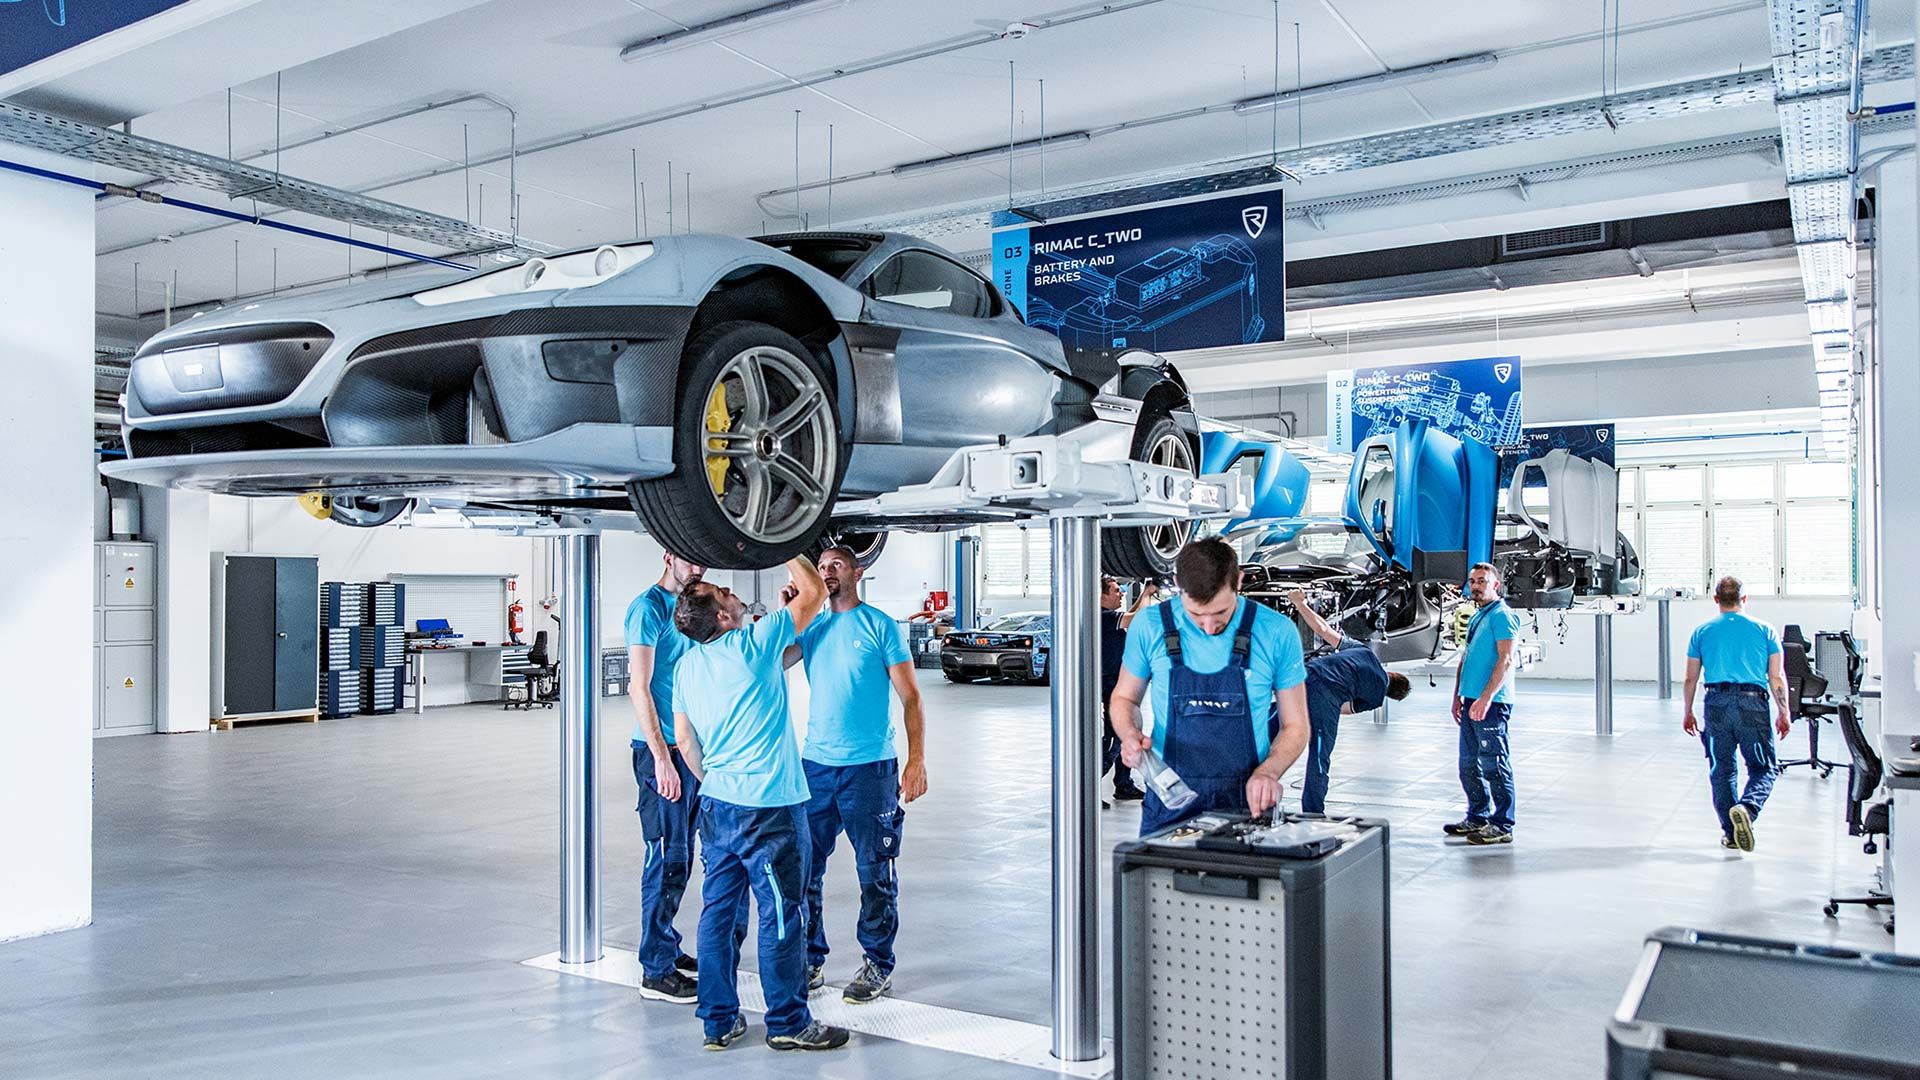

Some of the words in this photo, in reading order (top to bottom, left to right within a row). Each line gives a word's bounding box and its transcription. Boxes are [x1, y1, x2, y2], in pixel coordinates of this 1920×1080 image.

[1034, 237, 1083, 255] RIMAC
[1088, 228, 1142, 249] C_TWO
[1004, 246, 1022, 259] 03
[1034, 259, 1087, 275] BATTERY
[1089, 255, 1115, 267] AND
[1004, 269, 1012, 296] ZONE
[1034, 272, 1081, 287] BRAKES
[1335, 380, 1349, 388] 02
[1356, 375, 1391, 387] RIMAC
[1394, 372, 1430, 385] C_TWO
[1357, 387, 1410, 397] POWERTRAIN
[1411, 385, 1430, 394] AND
